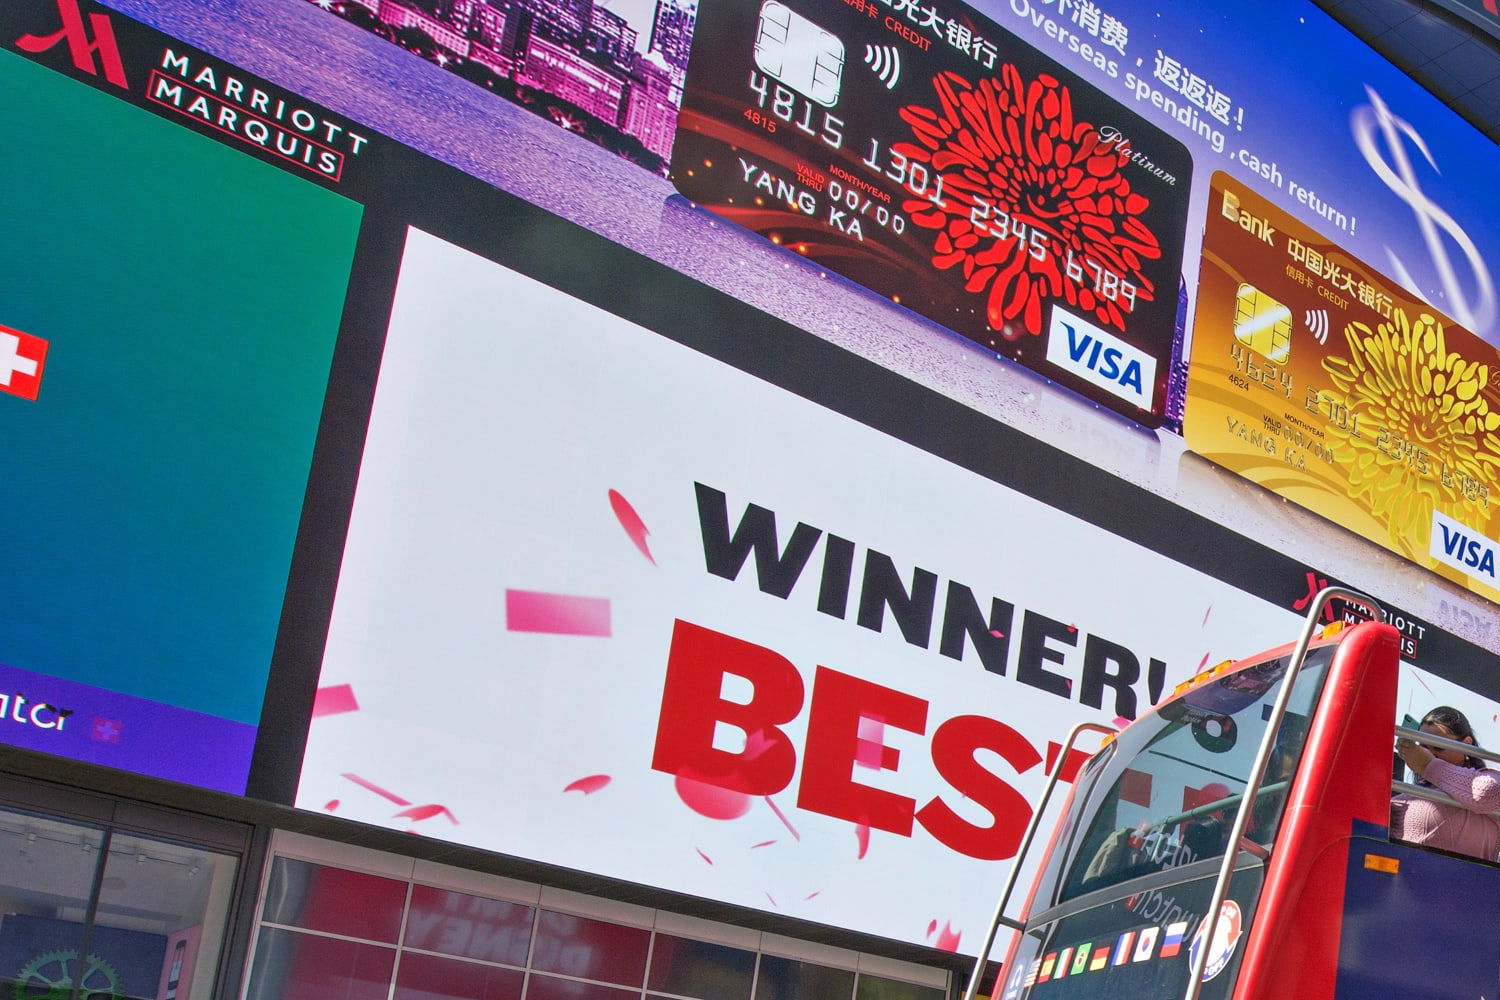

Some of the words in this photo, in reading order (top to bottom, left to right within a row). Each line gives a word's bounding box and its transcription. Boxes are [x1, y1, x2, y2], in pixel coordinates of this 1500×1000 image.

[884, 17, 932, 52] CREDIT
[154, 77, 338, 175] MARQUIS
[160, 47, 368, 156] MARRIOTT
[743, 109, 777, 134] 4815
[1010, 0, 1119, 79] Overseas
[1124, 69, 1226, 154] spending
[1288, 173, 1357, 236] return!
[797, 162, 825, 184] VALID
[797, 171, 824, 193] THRU
[829, 164, 892, 203] MONTH/YEAR
[1097, 124, 1178, 187] Platinum
[738, 157, 817, 216] YANG
[828, 210, 865, 243] KA
[750, 70, 845, 149] 4815
[863, 138, 948, 207] 1301
[970, 195, 1047, 262] 2345
[1066, 254, 1137, 311] 6789
[829, 179, 906, 236] 00/00
[1221, 190, 1275, 248] Bank
[1285, 264, 1315, 289] 信用卡
[1287, 238, 1393, 318] 中国光大银行
[1317, 285, 1349, 311] CREDIT
[1060, 319, 1144, 395] VISA
[1228, 374, 1250, 391] 4624
[1230, 341, 1292, 400] 4624
[1226, 416, 1277, 451] YANG
[1285, 446, 1308, 473] KA
[1284, 412, 1325, 440] MONTH/YEAR
[1437, 521, 1496, 578] VISA
[652, 618, 1092, 861] BES
